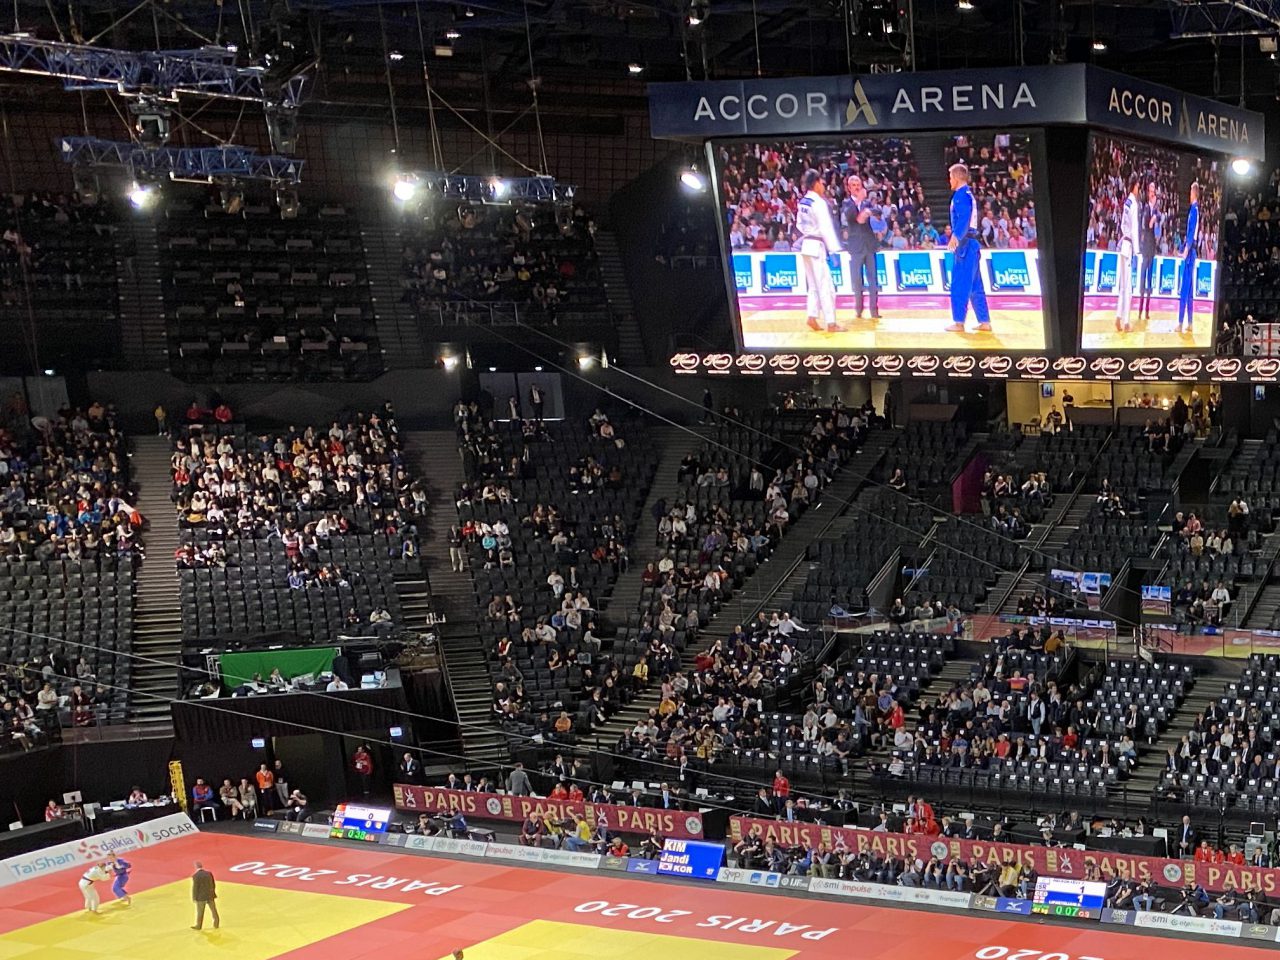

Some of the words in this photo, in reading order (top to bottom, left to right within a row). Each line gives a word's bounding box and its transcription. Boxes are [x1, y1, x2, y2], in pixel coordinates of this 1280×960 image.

[694, 92, 830, 121] ACCOR
[891, 82, 1037, 114] ARENA
[1109, 87, 1173, 127] ACCOR
[1197, 111, 1250, 144] ARENA
[766, 274, 797, 288] bleu
[901, 272, 933, 286] bleu
[996, 272, 1029, 286] bleu
[424, 791, 476, 813] PARIS
[617, 809, 674, 833] PARIS
[751, 822, 812, 846] PARIS
[11, 851, 76, 878] TaiShan
[100, 835, 134, 853] dalkia
[152, 823, 194, 841] SOCAR
[663, 840, 687, 853] KIM
[857, 834, 918, 857] PARIS
[973, 844, 1034, 868] PARIS
[661, 852, 690, 864] Jandi
[672, 864, 693, 874] KOR
[229, 861, 337, 881] 2020
[1208, 867, 1276, 892] PARIS
[334, 873, 463, 896] PARIS
[823, 880, 839, 890] smi
[842, 884, 872, 894] impulse
[1077, 894, 1083, 902] 1
[574, 900, 693, 924] 2020
[1151, 915, 1168, 924] smi
[696, 914, 840, 941] PARIS
